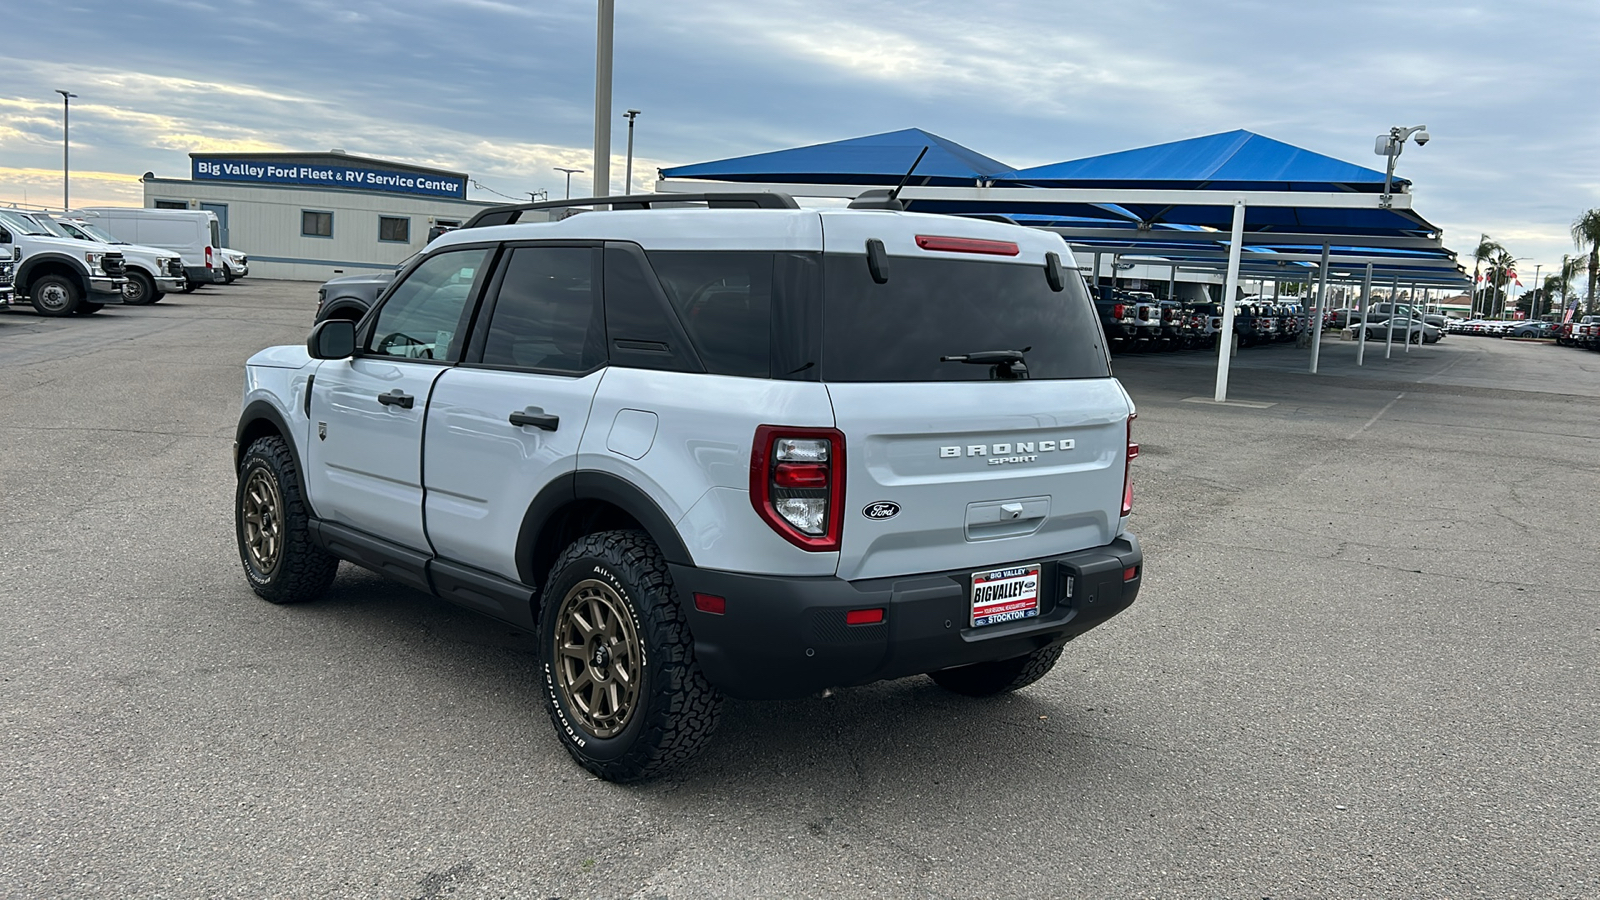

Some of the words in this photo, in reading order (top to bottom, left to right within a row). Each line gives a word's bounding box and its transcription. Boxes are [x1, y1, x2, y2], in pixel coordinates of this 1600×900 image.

[198, 162, 220, 176] Big
[223, 163, 264, 178] Valley
[267, 166, 297, 178] Ford
[300, 167, 333, 180] Fleet
[335, 172, 343, 180] &
[345, 171, 364, 182] RV
[366, 173, 414, 187] Service
[416, 177, 459, 192] Center
[940, 439, 1075, 458] BRONCO
[987, 455, 1038, 465] SPORT
[870, 504, 895, 517] Ford
[990, 571, 1002, 579] BIG
[1003, 568, 1026, 577] VALLEY
[593, 565, 640, 629] All-Terrain
[974, 580, 1025, 603] BIGVALLEY
[987, 610, 1025, 623] STOCKTON
[544, 663, 586, 748] BFGoodrich
